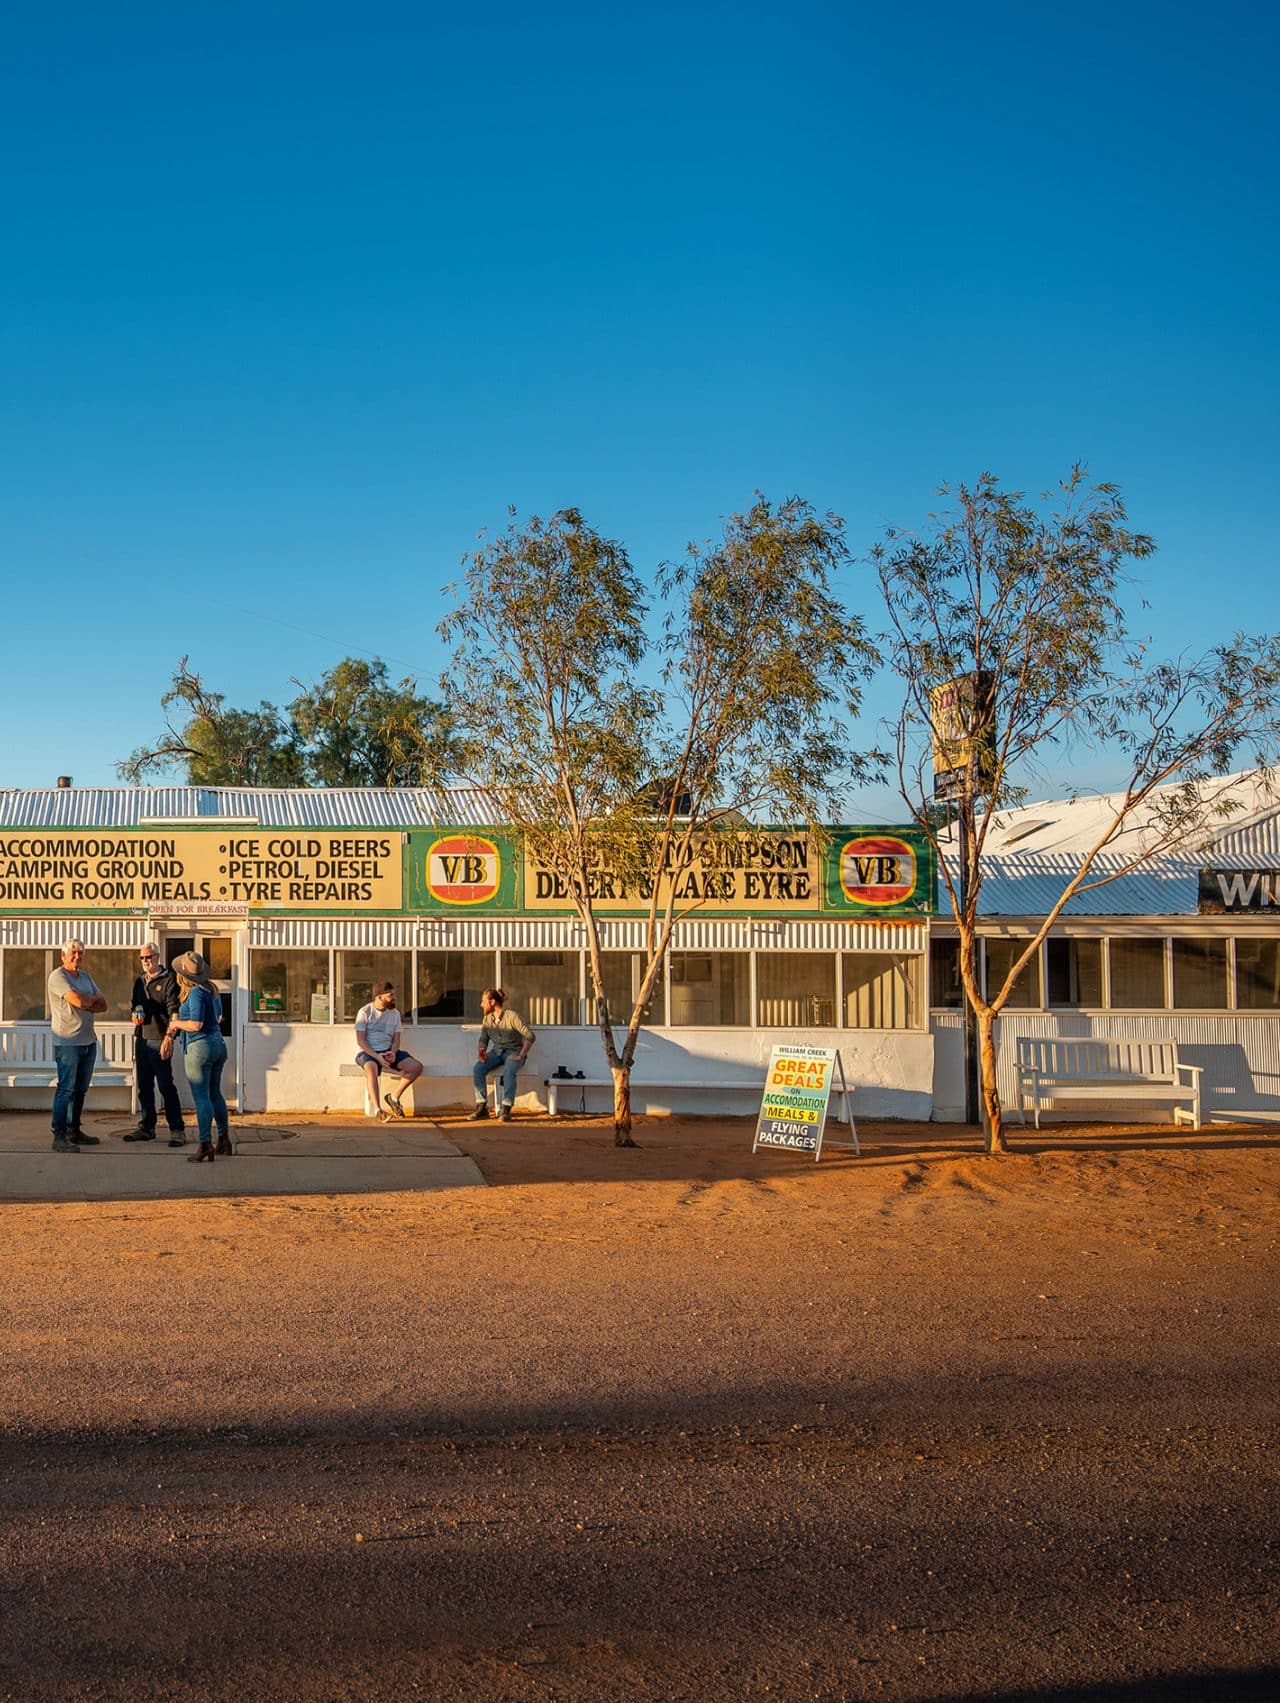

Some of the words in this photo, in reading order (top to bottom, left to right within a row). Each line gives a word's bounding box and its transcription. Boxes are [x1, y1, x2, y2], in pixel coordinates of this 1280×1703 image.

[229, 840, 259, 857] ICE
[268, 840, 321, 857] COLD
[330, 840, 391, 857] BEERS
[96, 860, 184, 878] GROUND
[229, 861, 310, 881] PETROL,
[316, 861, 383, 878] DIESEL
[438, 855, 487, 883] VB
[850, 856, 902, 884] VB
[72, 882, 134, 900] ROOM
[142, 882, 211, 900] MEALS
[230, 882, 281, 900] TYRE
[289, 882, 372, 900] REPAIRS
[744, 871, 811, 899] EYRE
[1217, 874, 1280, 906] WI
[197, 905, 248, 913] BREAKFAST
[779, 1047, 806, 1055] WILLIAM
[775, 1059, 827, 1075] GREAT
[772, 1073, 824, 1089] DEALS
[790, 1087, 800, 1095] ON
[765, 1093, 826, 1109] ACCOMODATION
[767, 1107, 805, 1120] MEALS
[808, 1111, 816, 1121] &
[771, 1122, 809, 1136] FLYING
[759, 1132, 816, 1149] PACKAGES
